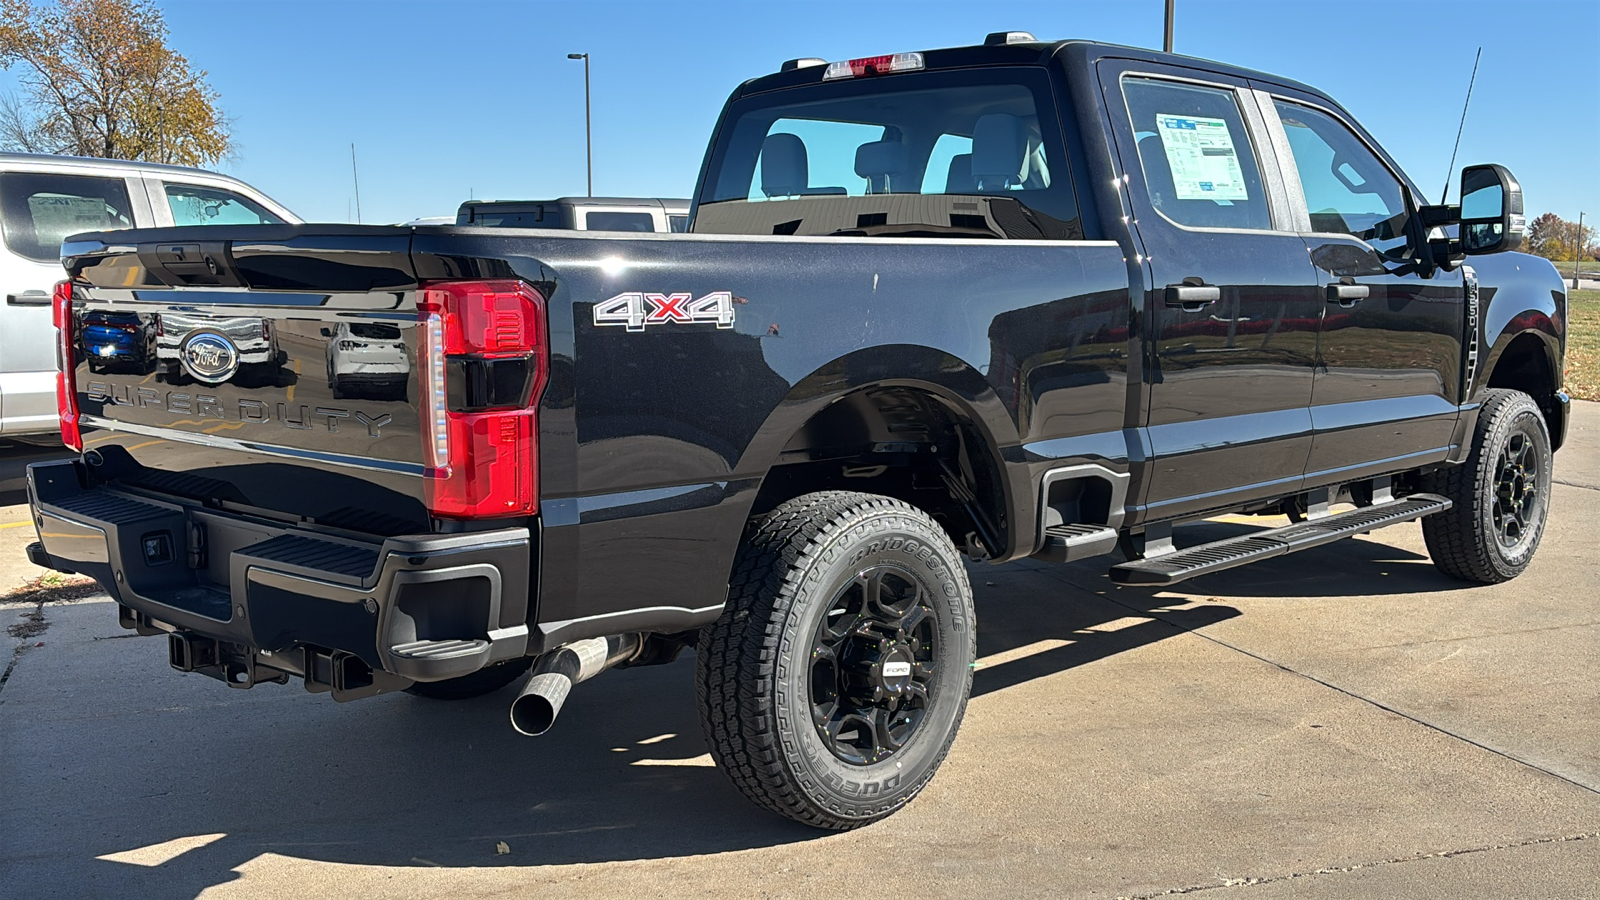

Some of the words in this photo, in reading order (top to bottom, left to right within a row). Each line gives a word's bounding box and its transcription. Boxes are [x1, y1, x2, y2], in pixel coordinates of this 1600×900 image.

[193, 342, 221, 367] Ford
[87, 381, 225, 419] SUPER
[238, 399, 392, 438] DUTY
[849, 537, 966, 634] BRIDGESTONE
[802, 731, 901, 799] DUELER
